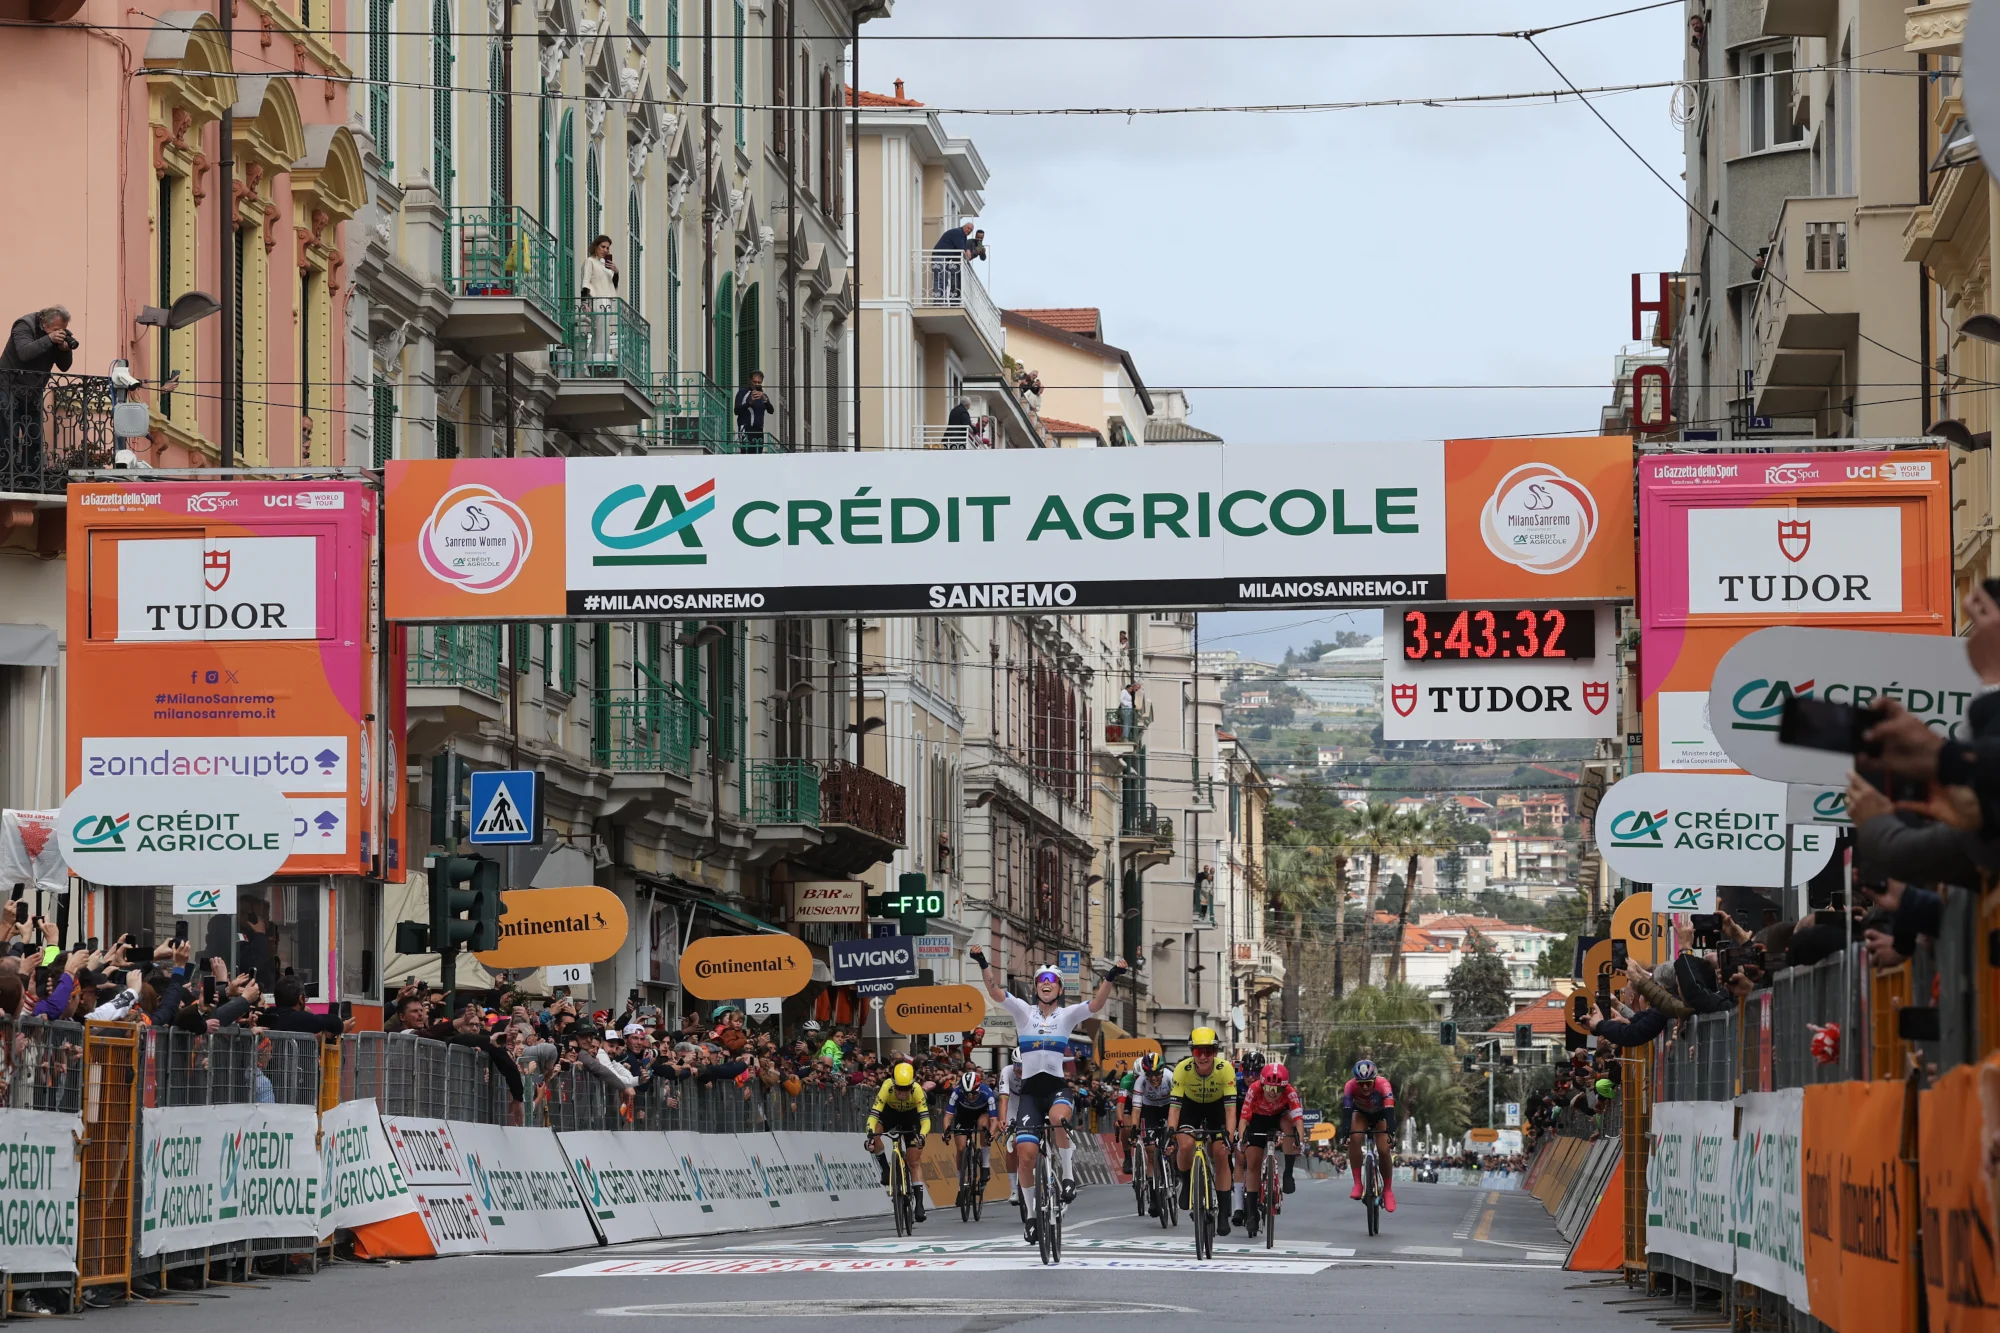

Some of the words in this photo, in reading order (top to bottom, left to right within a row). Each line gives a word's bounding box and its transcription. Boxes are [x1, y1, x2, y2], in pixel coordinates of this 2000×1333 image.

[1654, 467, 1664, 478] La
[1664, 466, 1697, 478] Gazzetta
[1697, 465, 1716, 477] dello
[1716, 464, 1738, 479] Sport
[1765, 464, 1798, 484] RCS
[1797, 469, 1820, 481] Sport
[1846, 466, 1876, 479] UCI
[81, 494, 91, 506] La
[90, 493, 122, 505] Gazzetta
[122, 492, 141, 505] dello
[141, 492, 161, 506] Sport
[186, 493, 218, 512] RCS
[217, 497, 238, 508] Sport
[264, 495, 292, 507] UCI
[732, 486, 1010, 548] CRÉDIT
[1026, 487, 1420, 542] AGRICOLE
[1508, 514, 1570, 527] MilanoSanremo
[445, 536, 477, 547] Sanremo
[478, 536, 507, 547] Women
[928, 582, 1077, 609] SANREMO
[1239, 581, 1428, 598] MILANOSANREMO.IT
[1719, 574, 1871, 602] TUDOR
[584, 592, 765, 611] #MILANOSANREMO
[146, 602, 287, 630] TUDOR
[1406, 609, 1566, 659] 3:43:32
[155, 692, 275, 705] #MilanoSanremo
[1428, 685, 1572, 712] TUDOR
[154, 707, 275, 720] milanosanremo.it
[137, 810, 240, 831] CRÉDIT
[1674, 808, 1779, 830] CRÉDIT
[136, 833, 279, 851] AGRICOLE
[803, 889, 843, 899] BAR
[796, 906, 860, 916] MUSICANTI
[918, 938, 950, 946] HOTEL
[695, 956, 782, 978] Continental
[838, 949, 909, 968] LIVIGNO
[562, 968, 580, 981] 10
[857, 983, 894, 993] LIVIGNO
[754, 1002, 769, 1014] 25
[896, 1002, 963, 1017] Continental
[944, 1034, 955, 1043] 50
[243, 1122, 293, 1170] CRÉDIT
[334, 1119, 370, 1165] CRÉDIT
[400, 1129, 452, 1172] TUDOR
[162, 1127, 201, 1179] CRÉDIT
[1700, 1124, 1722, 1183] CRÉDIT
[333, 1161, 408, 1209] AGRICOLE
[488, 1160, 528, 1211] CRÉDIT
[525, 1171, 580, 1211] AGRICOLE
[599, 1161, 645, 1205] CRÉDIT
[636, 1169, 692, 1202] AGRICOLE
[721, 1168, 762, 1199] AGRICOLE
[160, 1183, 213, 1229] AGRICOLE
[240, 1177, 317, 1217] AGRICOLE
[428, 1197, 480, 1240] TUDOR
[1699, 1192, 1725, 1243] AGRICOLE
